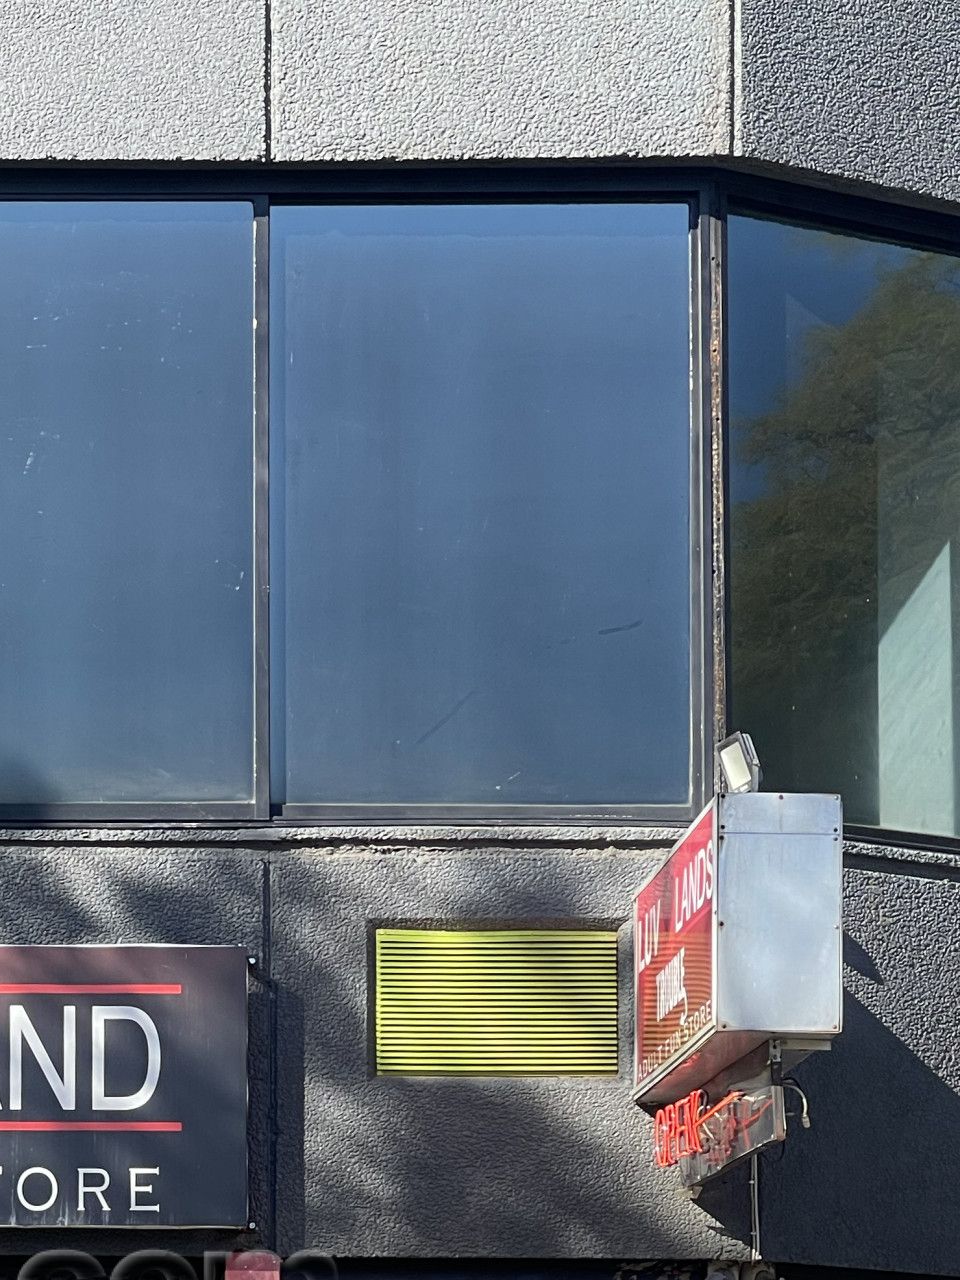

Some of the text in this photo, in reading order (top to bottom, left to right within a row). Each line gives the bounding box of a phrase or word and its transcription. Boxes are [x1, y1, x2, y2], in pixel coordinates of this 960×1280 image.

[638, 839, 714, 974] LUV LANDS
[637, 999, 712, 1081] ADULT FUN STORE
